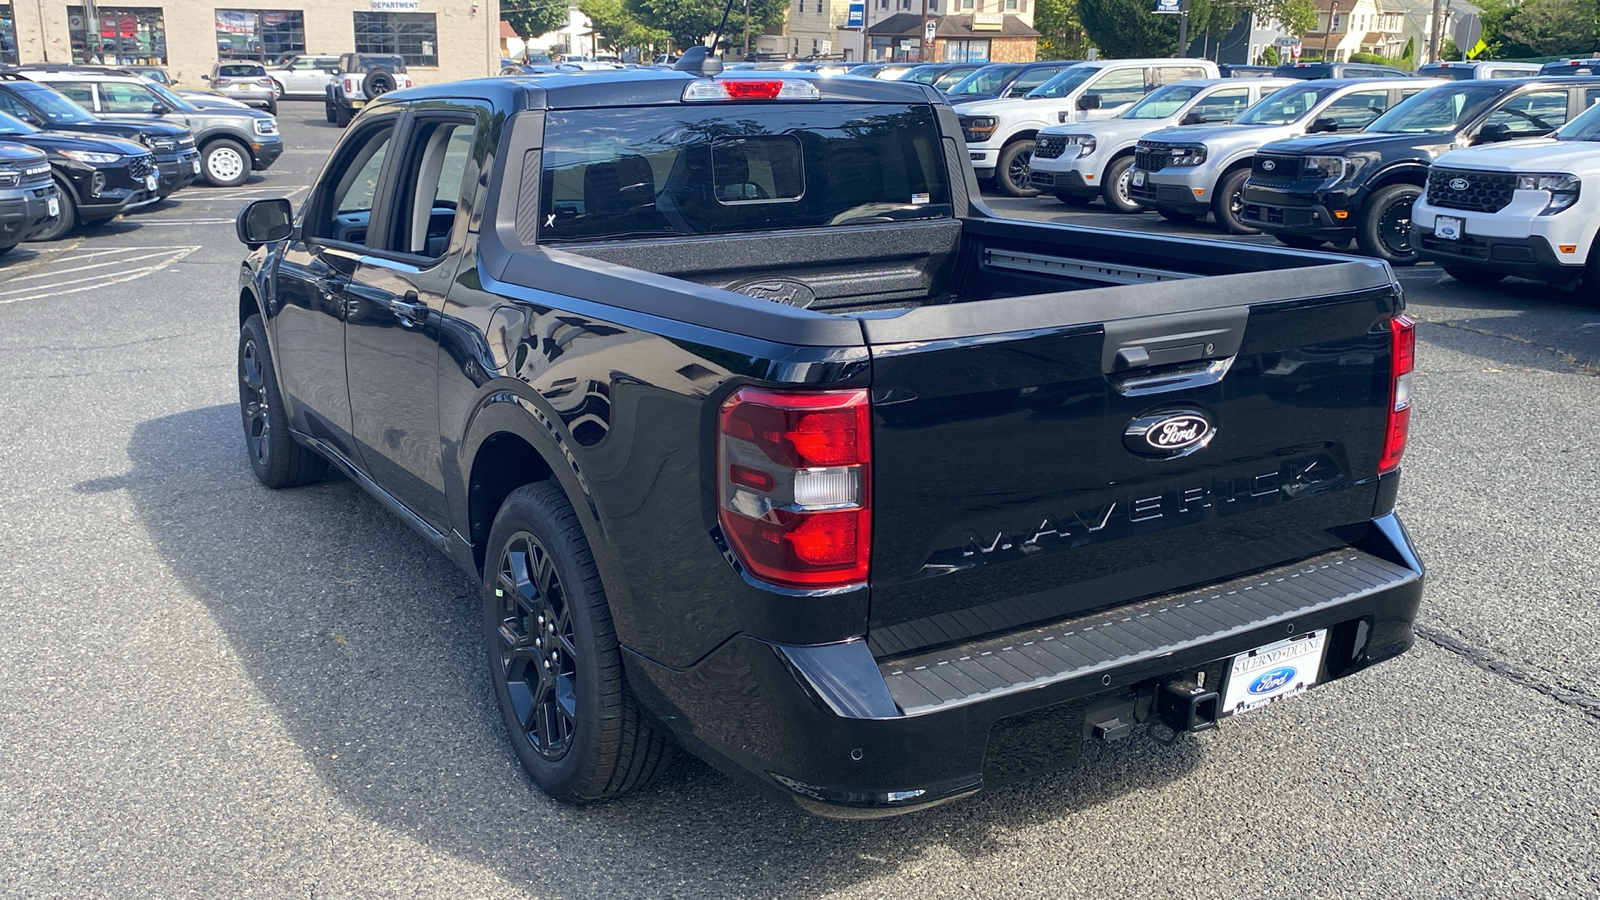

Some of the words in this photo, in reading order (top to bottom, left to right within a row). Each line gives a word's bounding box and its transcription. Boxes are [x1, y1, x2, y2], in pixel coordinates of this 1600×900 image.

[1158, 420, 1198, 444] Ford
[962, 460, 1321, 557] MAVERICK
[1233, 650, 1282, 674] SALERNO
[1286, 637, 1322, 657] DUANE
[1256, 671, 1290, 692] Ford
